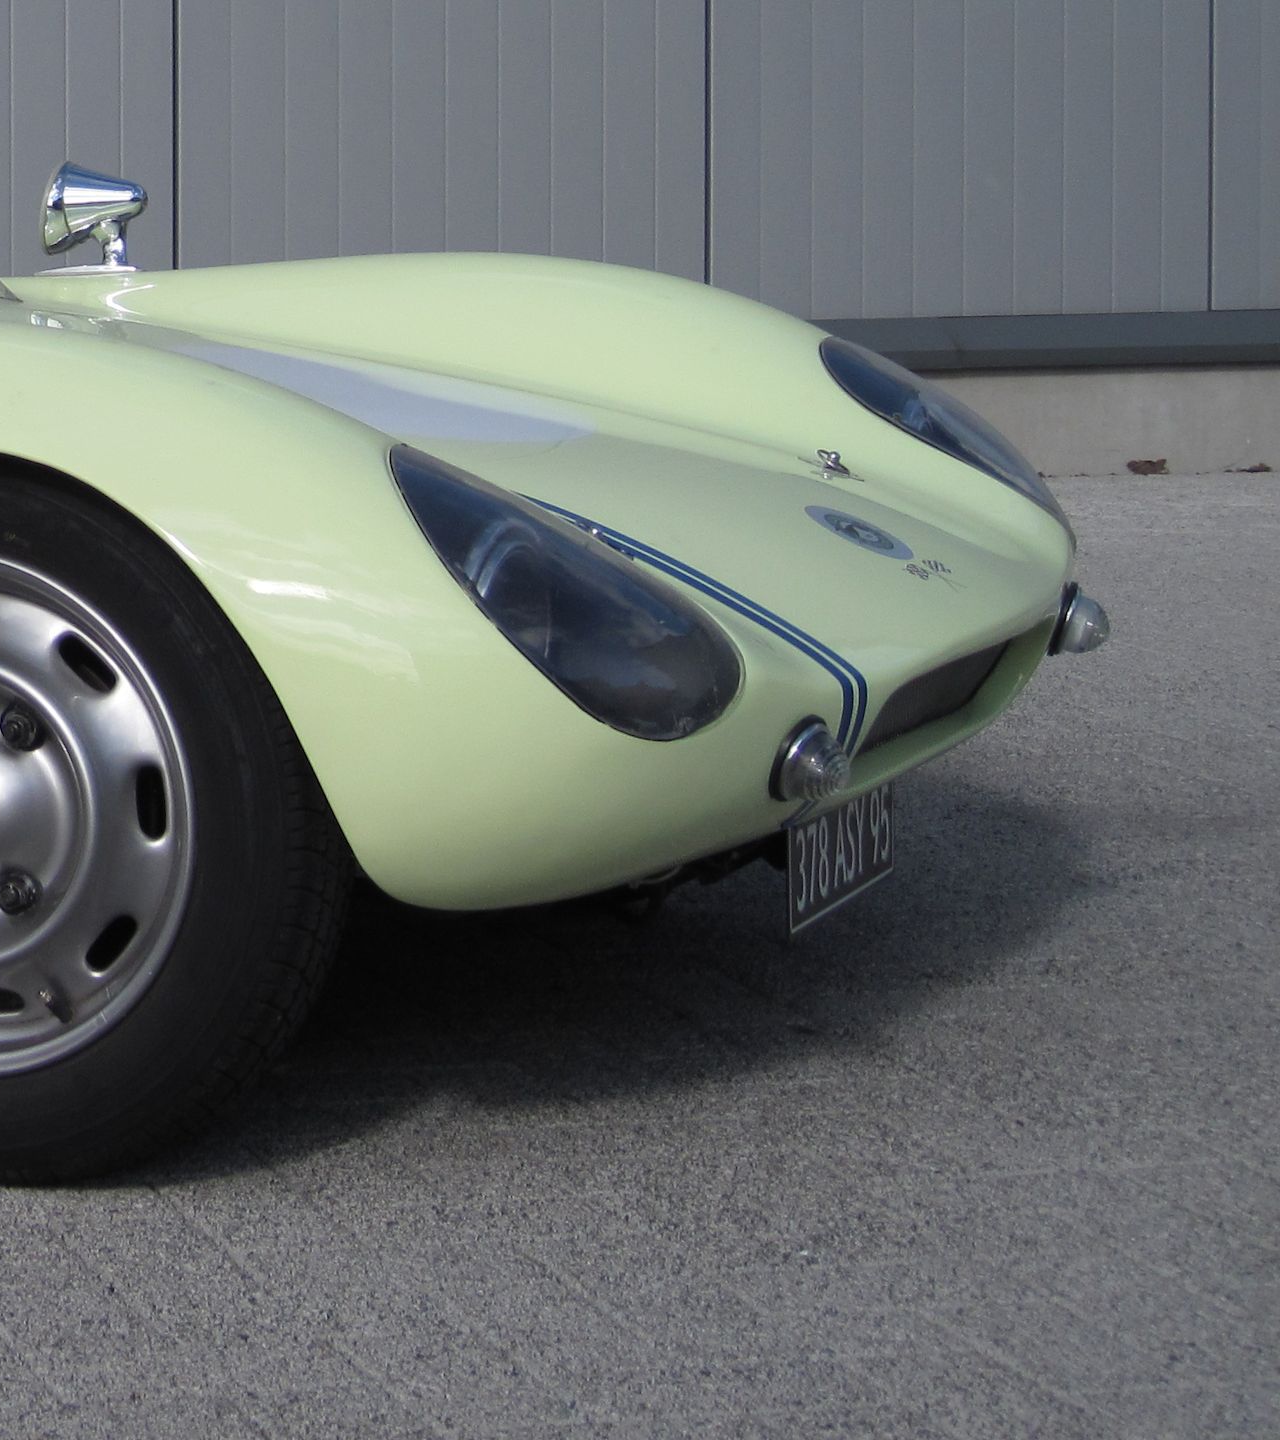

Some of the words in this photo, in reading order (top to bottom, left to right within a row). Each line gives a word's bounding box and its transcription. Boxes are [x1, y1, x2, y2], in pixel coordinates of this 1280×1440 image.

[796, 815, 829, 912] 378
[833, 795, 866, 888] ASY
[870, 784, 890, 864] 95
